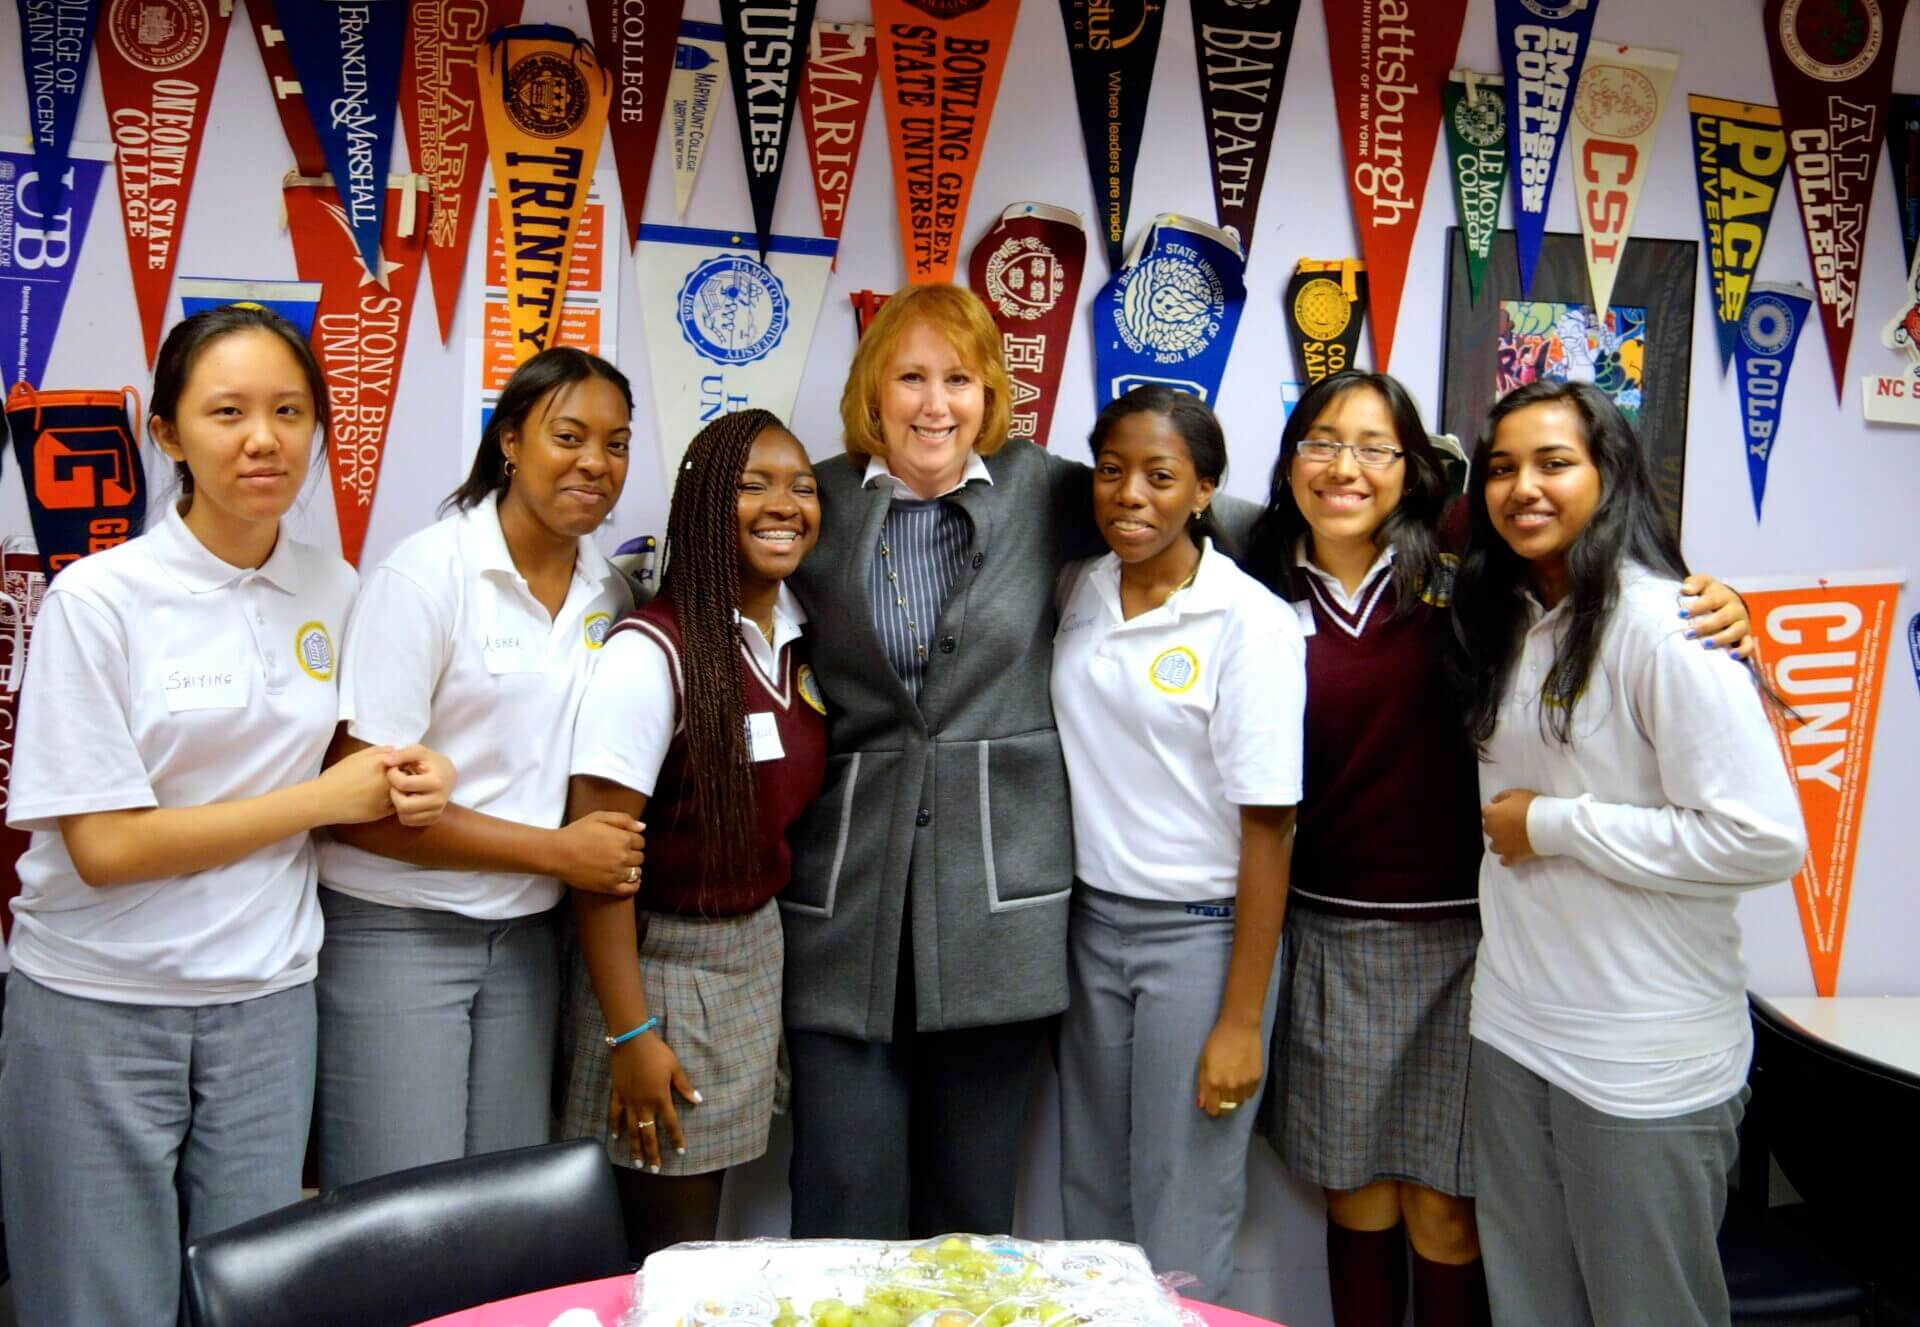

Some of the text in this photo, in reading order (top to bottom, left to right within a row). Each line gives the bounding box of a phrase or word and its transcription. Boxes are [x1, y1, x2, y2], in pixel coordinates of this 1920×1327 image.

[33, 61, 55, 146] VINCENT
[56, 66, 79, 95] OF
[338, 6, 370, 108] FRANKLIN
[621, 0, 646, 123] COLLEGE
[891, 24, 938, 107] STATE
[1202, 24, 1281, 208] BAY PATH
[1513, 24, 1549, 213] COLLEGE
[112, 108, 150, 238] COLLEGE
[148, 79, 200, 270] ONEONTA STATE
[346, 113, 379, 228] MARSHALL
[438, 0, 488, 248] CLARK
[686, 73, 718, 173] MARYMOUNT COLLEGE
[808, 46, 863, 222] MARIST
[934, 36, 990, 266] BOWLING GREEN
[1108, 71, 1123, 242] Where leaders are made
[1359, 122, 1368, 156] YORK
[1479, 150, 1504, 174] LE
[1530, 27, 1579, 214] EMERSON
[3, 184, 15, 250] UNIVERSITY
[506, 146, 584, 352] TRINITY
[1457, 153, 1480, 251] COLLEGE
[1479, 183, 1500, 259] MOYNE
[1583, 138, 1638, 265] CSI
[1697, 117, 1727, 323] UNIVERSITY
[1719, 121, 1787, 321] PACE
[1790, 129, 1837, 304] COLLEGE
[1829, 96, 1876, 328] ALMA
[726, 259, 783, 360] HAMPTON UNIVERSITY
[1113, 288, 1124, 304] AT
[1113, 309, 1143, 354] GENESEO
[1154, 243, 1225, 364] STATE UNIVERSITY OF NEW YORK
[357, 295, 402, 507] STONY BROOK
[1746, 357, 1782, 461] COLBY
[1876, 377, 1905, 398] NC
[1765, 601, 1862, 791] CUNY
